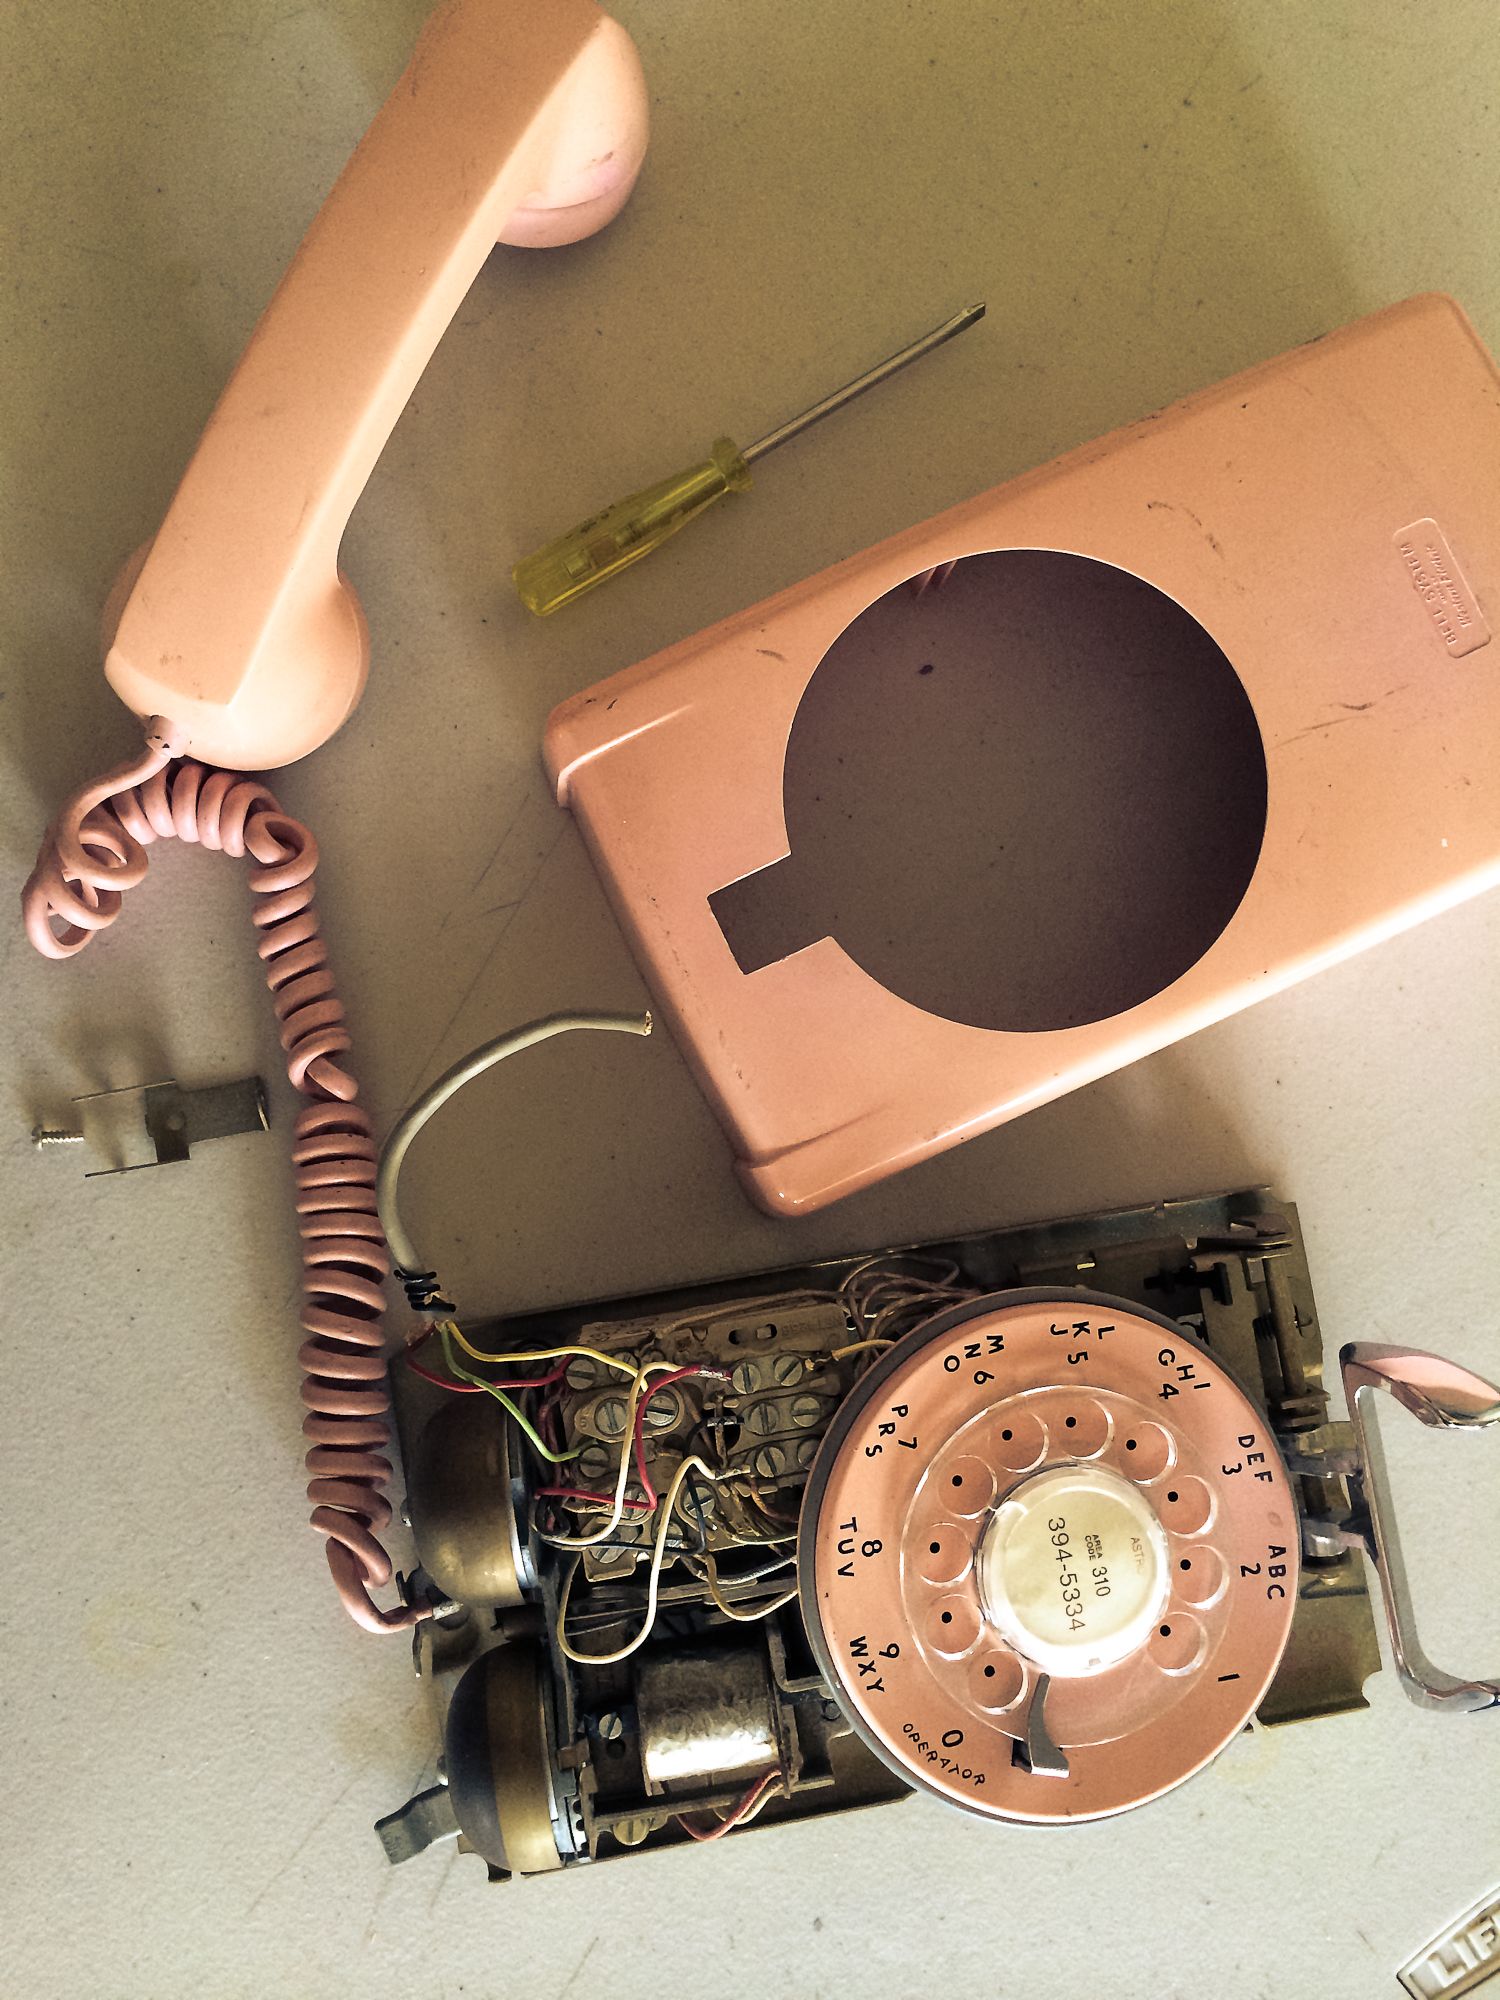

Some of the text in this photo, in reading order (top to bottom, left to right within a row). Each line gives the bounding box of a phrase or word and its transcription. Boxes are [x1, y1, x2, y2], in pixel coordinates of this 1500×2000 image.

[1400, 542, 1438, 603] SYSTEM
[1432, 608, 1457, 646] BELL
[1067, 1351, 1089, 1365] 5
[973, 1370, 995, 1385] 6
[1158, 1383, 1180, 1400] 4
[897, 1436, 918, 1450] 7
[1221, 1462, 1243, 1476] 3
[861, 1539, 883, 1558] 8
[1085, 1535, 1096, 1561] CODE
[1092, 1534, 1103, 1559] AREA
[1048, 1517, 1086, 1631] 394-5334
[1240, 1562, 1262, 1578] 2
[1092, 1566, 1111, 1597] 310
[878, 1643, 900, 1659] 9
[903, 1723, 985, 1785] OPERATOR
[1427, 1911, 1500, 1988] LIF
